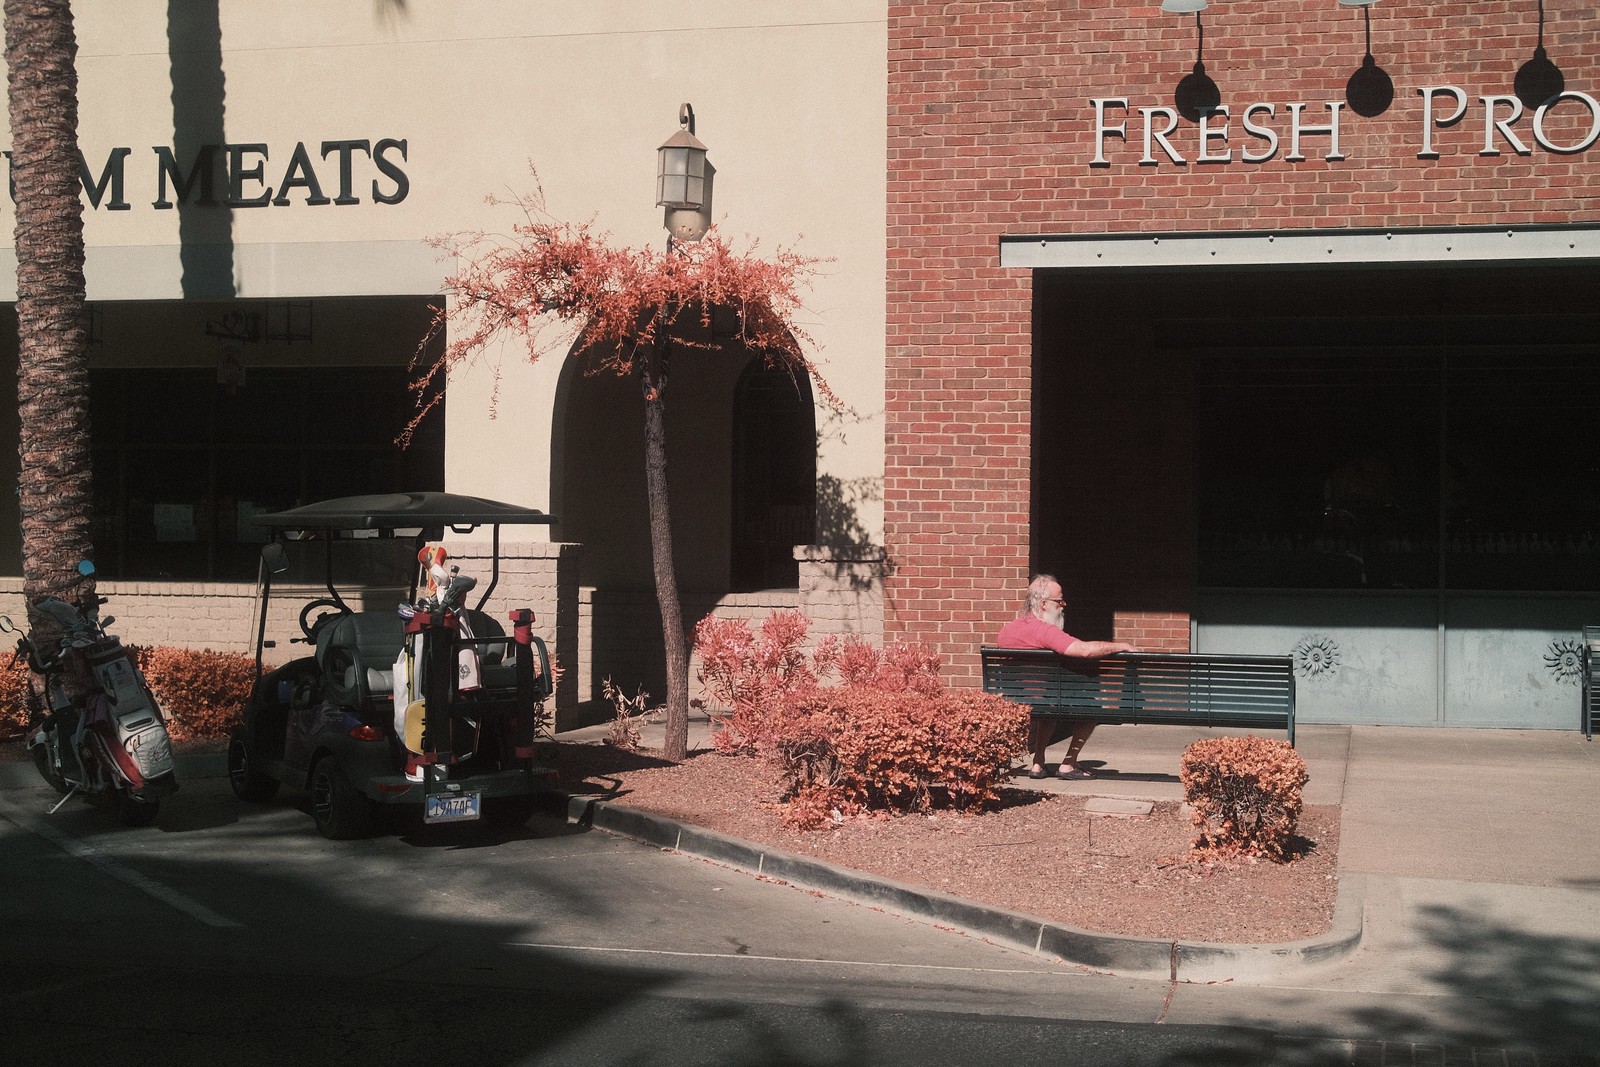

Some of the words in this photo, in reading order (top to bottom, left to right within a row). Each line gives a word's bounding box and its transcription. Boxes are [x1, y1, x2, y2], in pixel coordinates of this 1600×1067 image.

[1089, 97, 1346, 168] FRESH
[1417, 85, 1600, 161] PRO
[151, 138, 410, 210] MEATS
